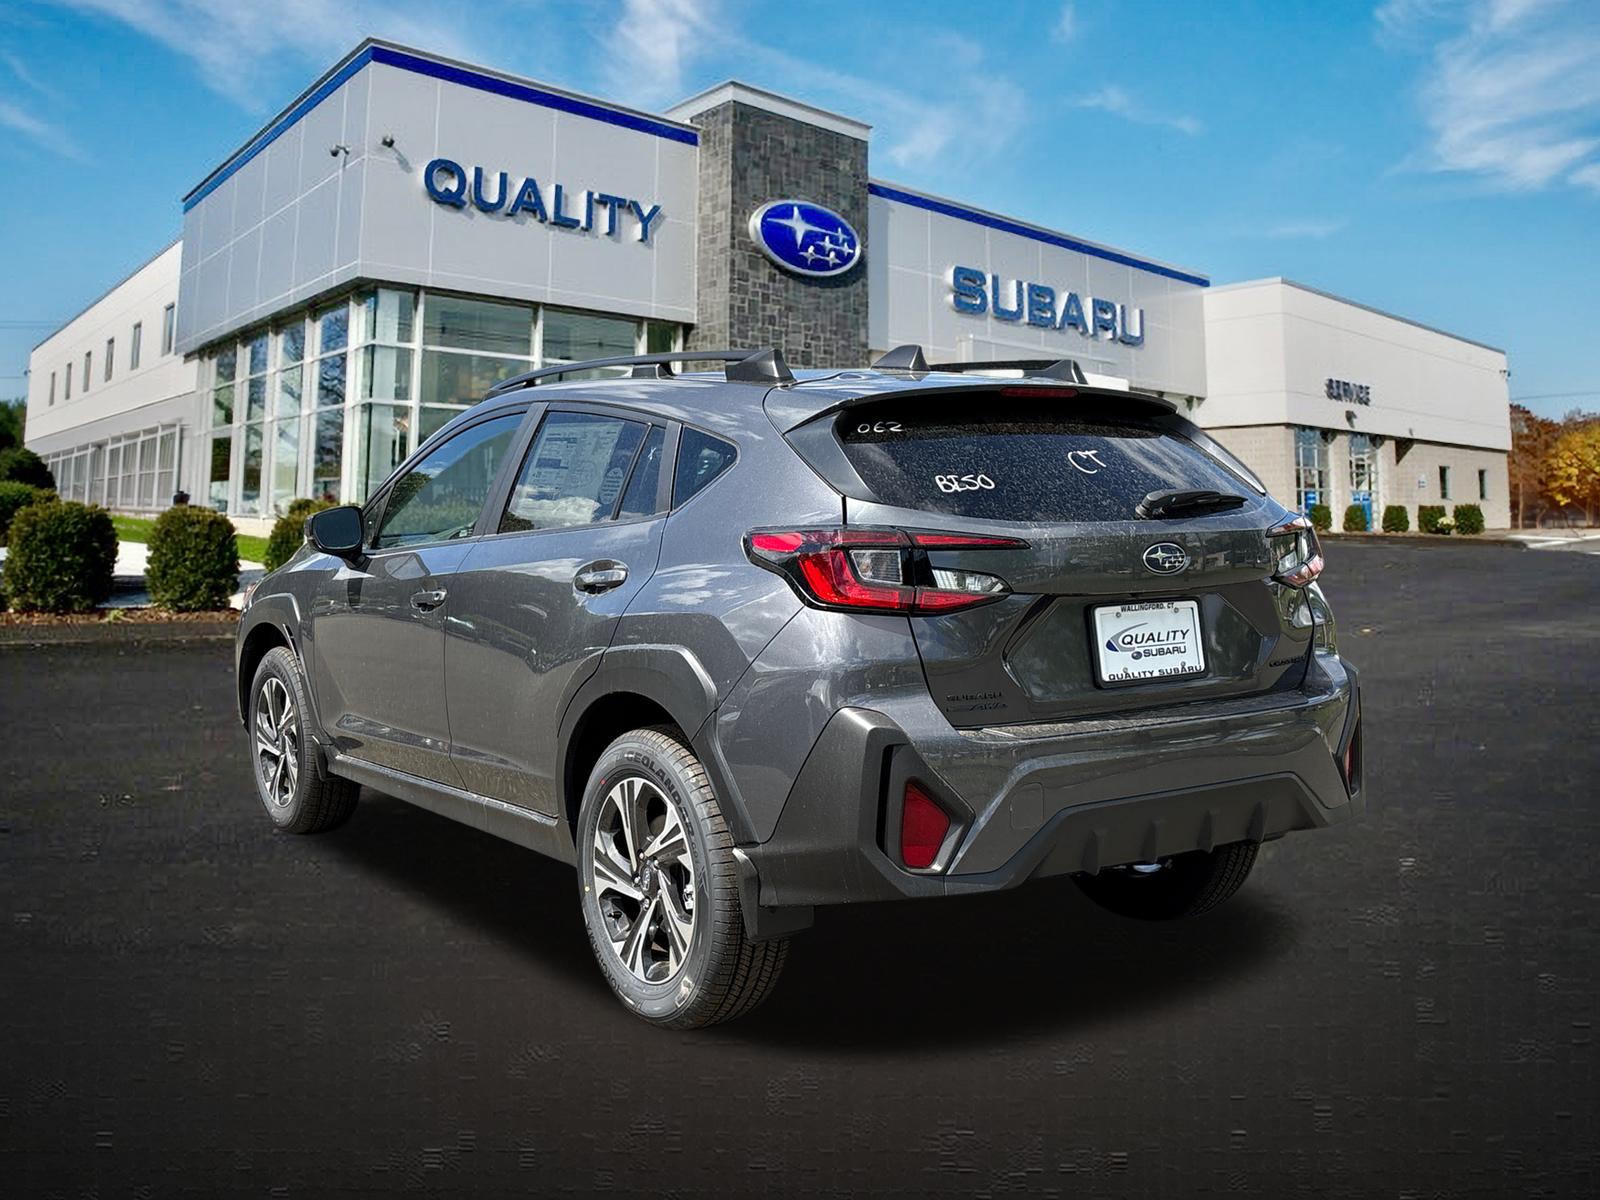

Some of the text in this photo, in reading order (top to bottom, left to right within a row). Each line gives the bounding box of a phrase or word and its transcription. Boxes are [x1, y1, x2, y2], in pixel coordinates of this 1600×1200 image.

[423, 158, 662, 243] QUALITY
[951, 265, 1145, 347] SUBARU
[1121, 629, 1190, 646] QUALITY
[1143, 646, 1187, 657] SUBARU
[1108, 665, 1203, 681] QUALITY SUBARU
